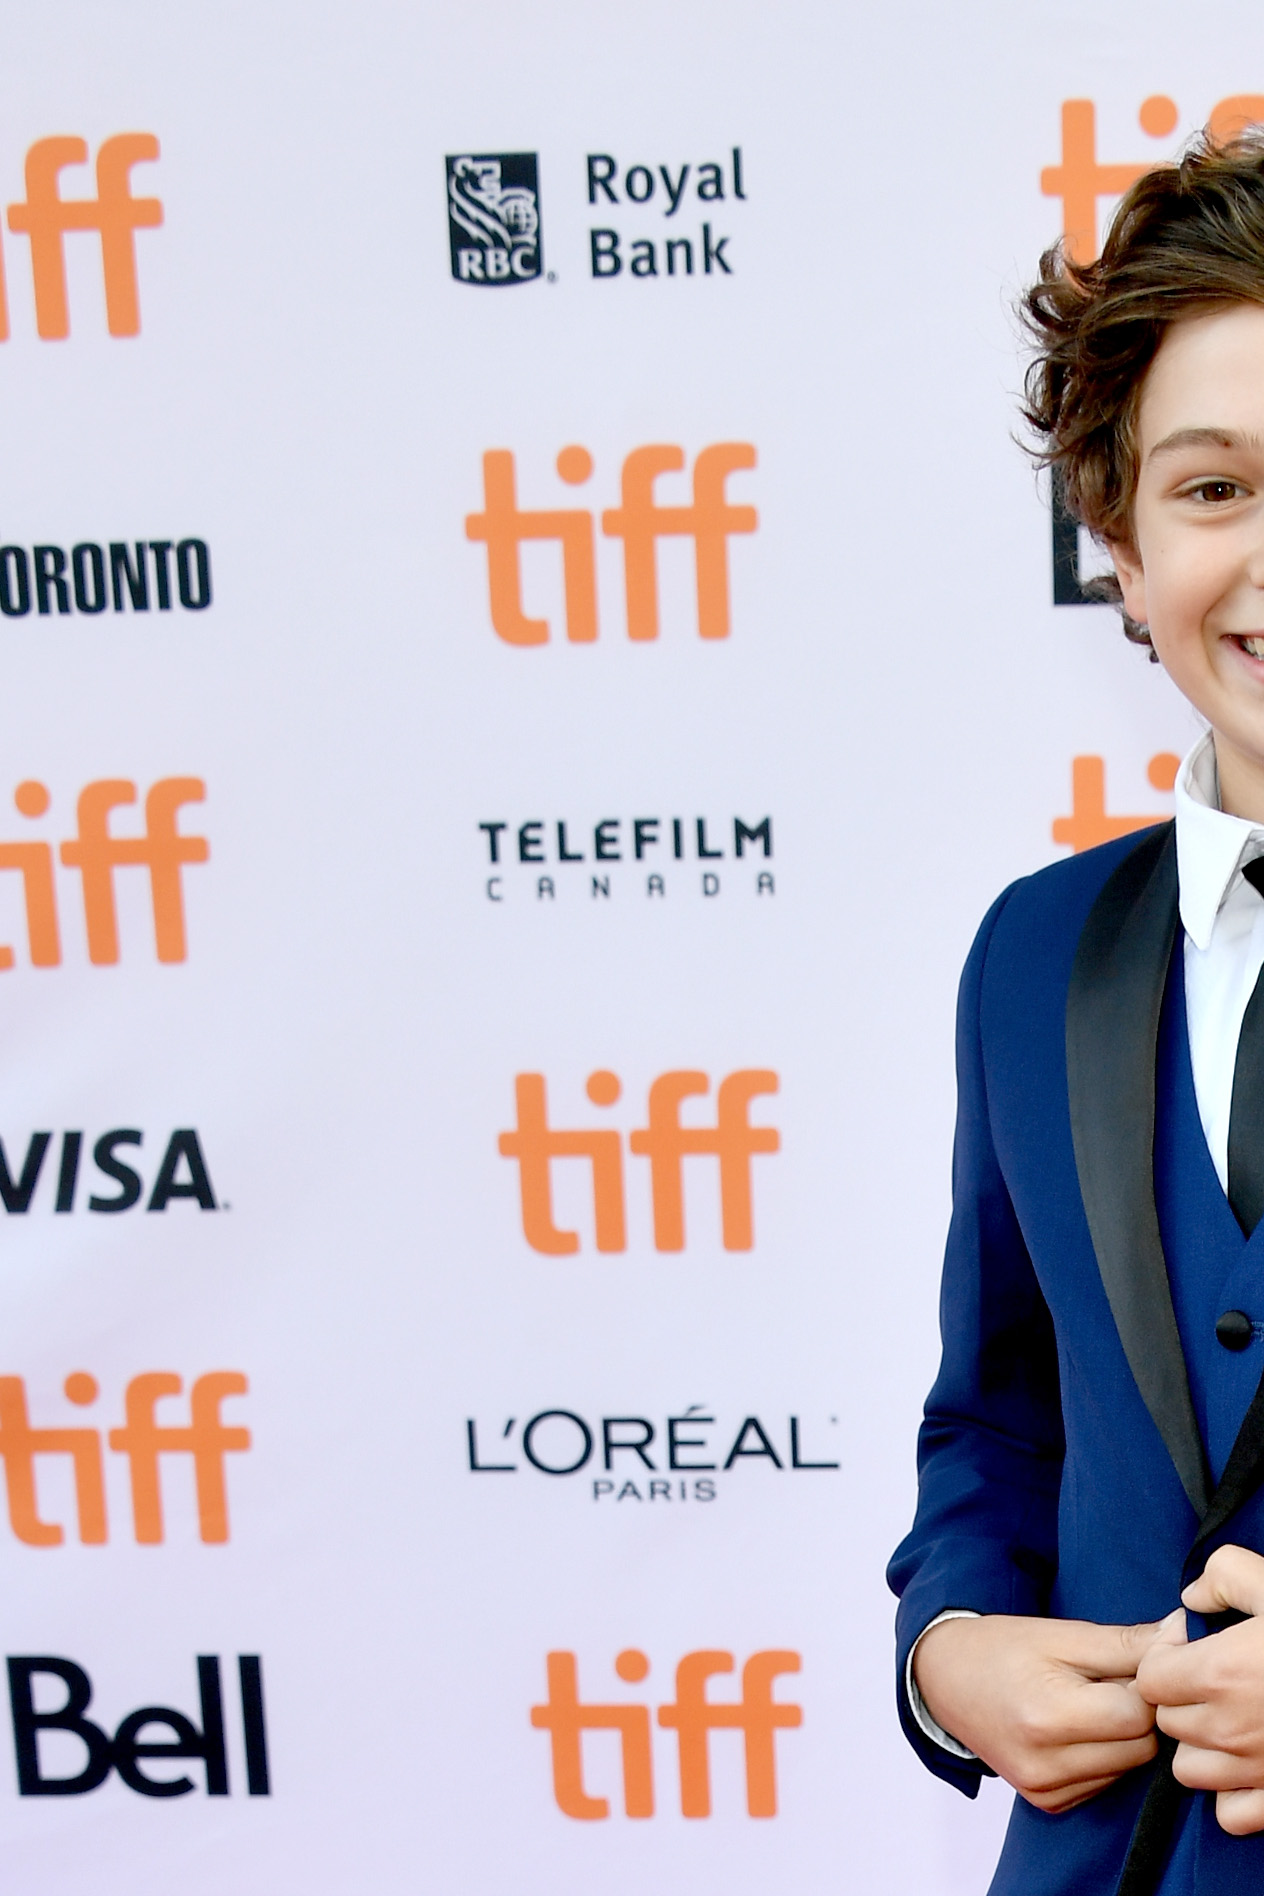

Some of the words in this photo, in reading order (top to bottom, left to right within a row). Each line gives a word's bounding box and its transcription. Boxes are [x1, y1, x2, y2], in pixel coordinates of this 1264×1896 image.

[586, 146, 747, 217] Royal
[457, 247, 538, 280] RBC
[589, 222, 733, 279] Bank
[0, 537, 213, 618] ORONTO
[465, 442, 758, 646] tiff
[0, 775, 209, 970] iff
[478, 816, 773, 864] TELEFILM
[486, 872, 775, 902] CANADA
[498, 1069, 780, 1256] tiff
[0, 1370, 251, 1547] tiff
[466, 1405, 840, 1475] L'ORÉAL
[592, 1478, 717, 1502] PARIS
[5, 1653, 272, 1799] Bell
[530, 1648, 803, 1821] tiff
